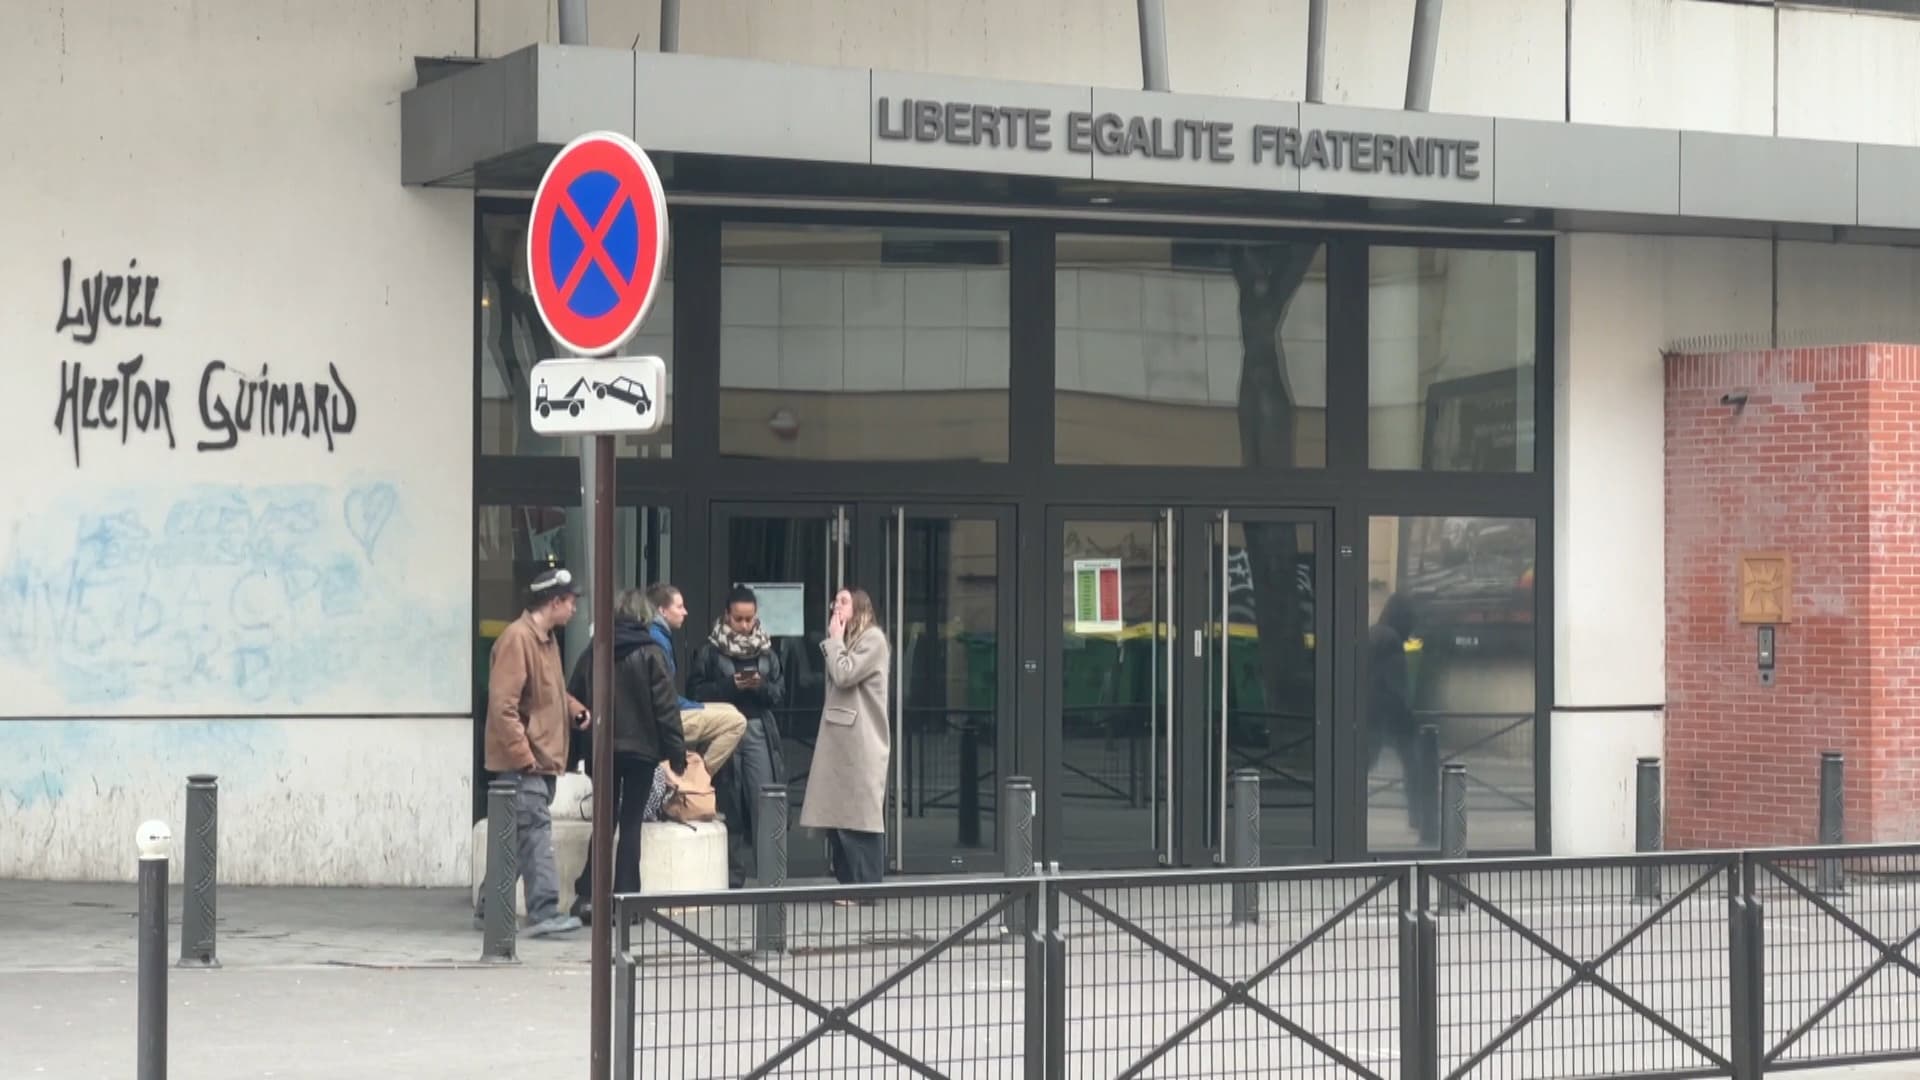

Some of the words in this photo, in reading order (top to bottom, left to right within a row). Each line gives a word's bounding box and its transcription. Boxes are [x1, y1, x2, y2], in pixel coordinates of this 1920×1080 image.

[878, 97, 1052, 151] LIBERTE
[1067, 111, 1235, 162] EGALITE
[1252, 124, 1480, 180] FRATERNITE
